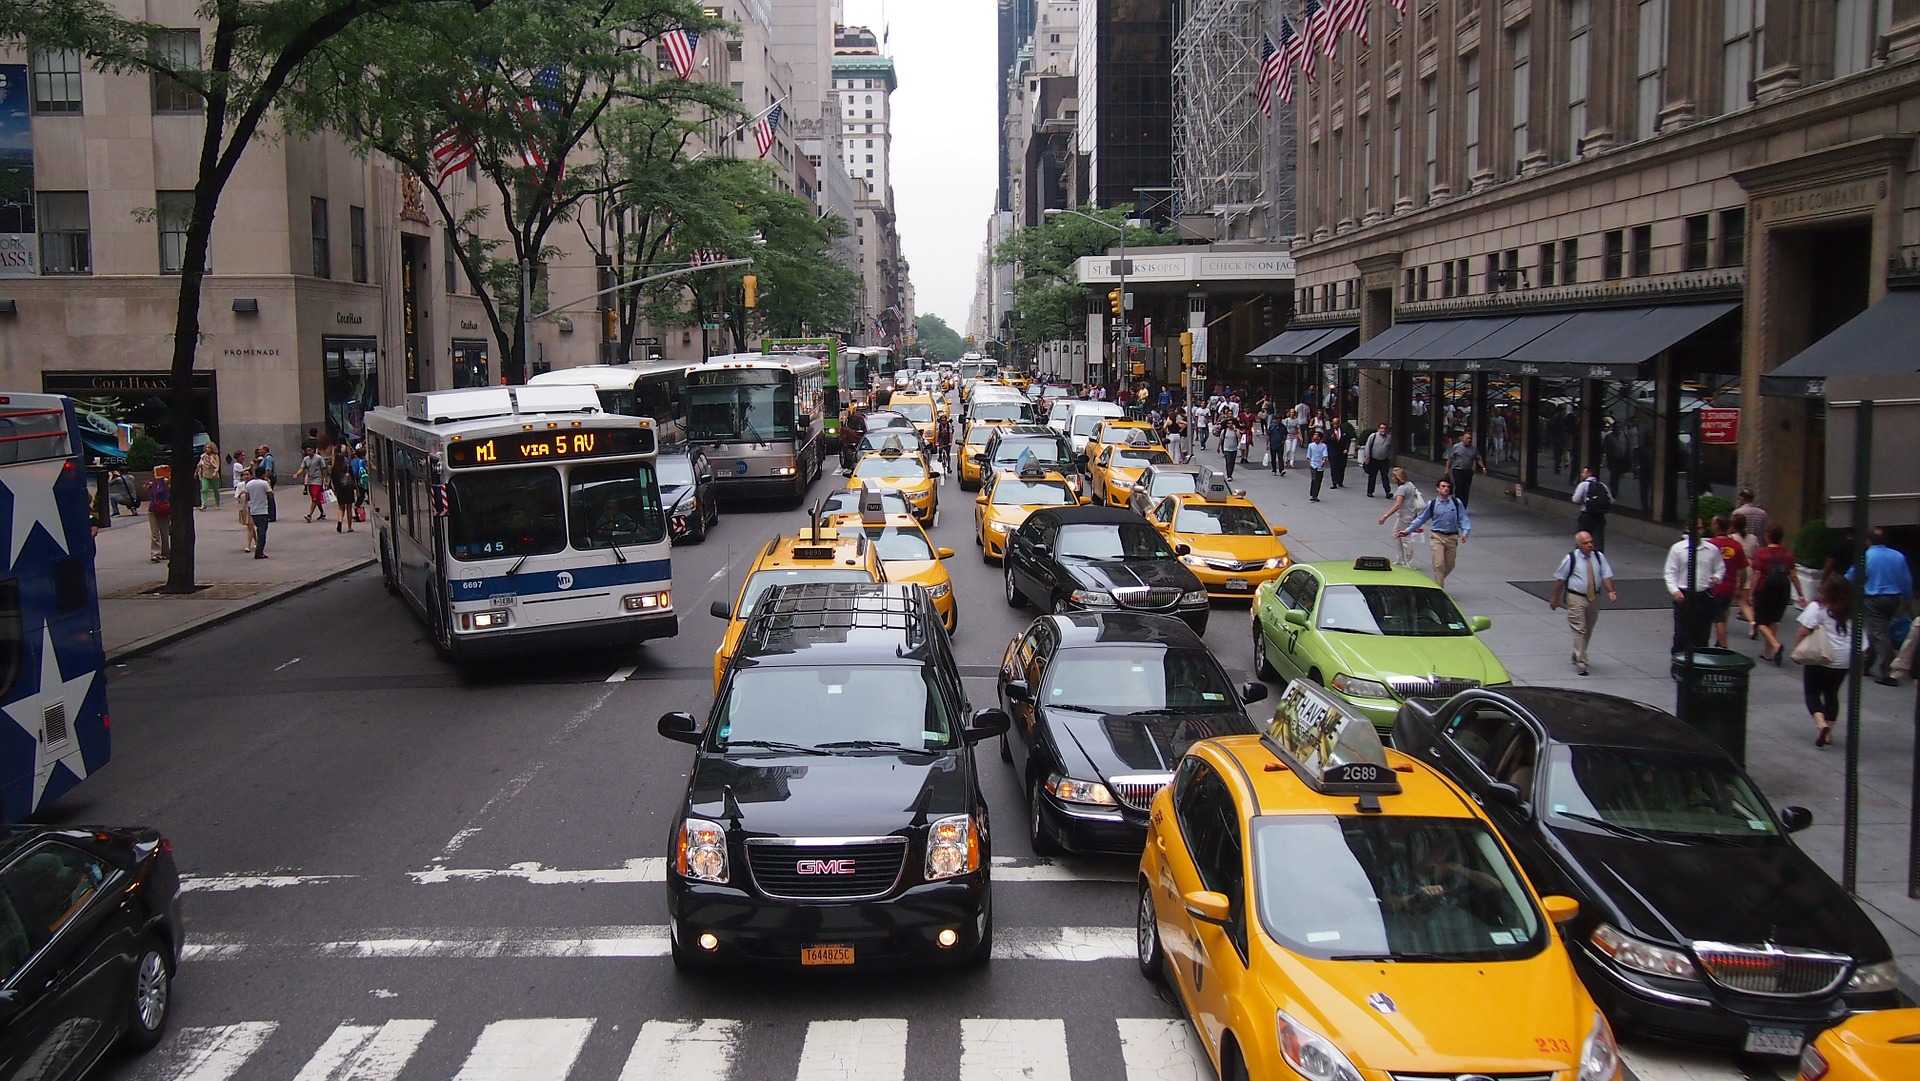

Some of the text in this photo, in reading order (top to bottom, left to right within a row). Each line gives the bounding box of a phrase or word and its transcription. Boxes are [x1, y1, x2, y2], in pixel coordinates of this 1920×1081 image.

[1148, 264, 1156, 272] IS
[1157, 262, 1180, 273] OPEN
[1209, 261, 1242, 270] CHECK
[1245, 261, 1256, 270] IN
[1258, 261, 1274, 270] ON
[476, 433, 595, 462] M1 VIA 5 AV
[462, 580, 483, 589] 6697
[557, 576, 572, 587] MTA
[1302, 702, 1343, 741] AVEE
[1342, 766, 1377, 781] 2G89
[796, 859, 856, 875] GMC
[806, 949, 850, 961] T644825C
[1534, 1037, 1572, 1054] 233
